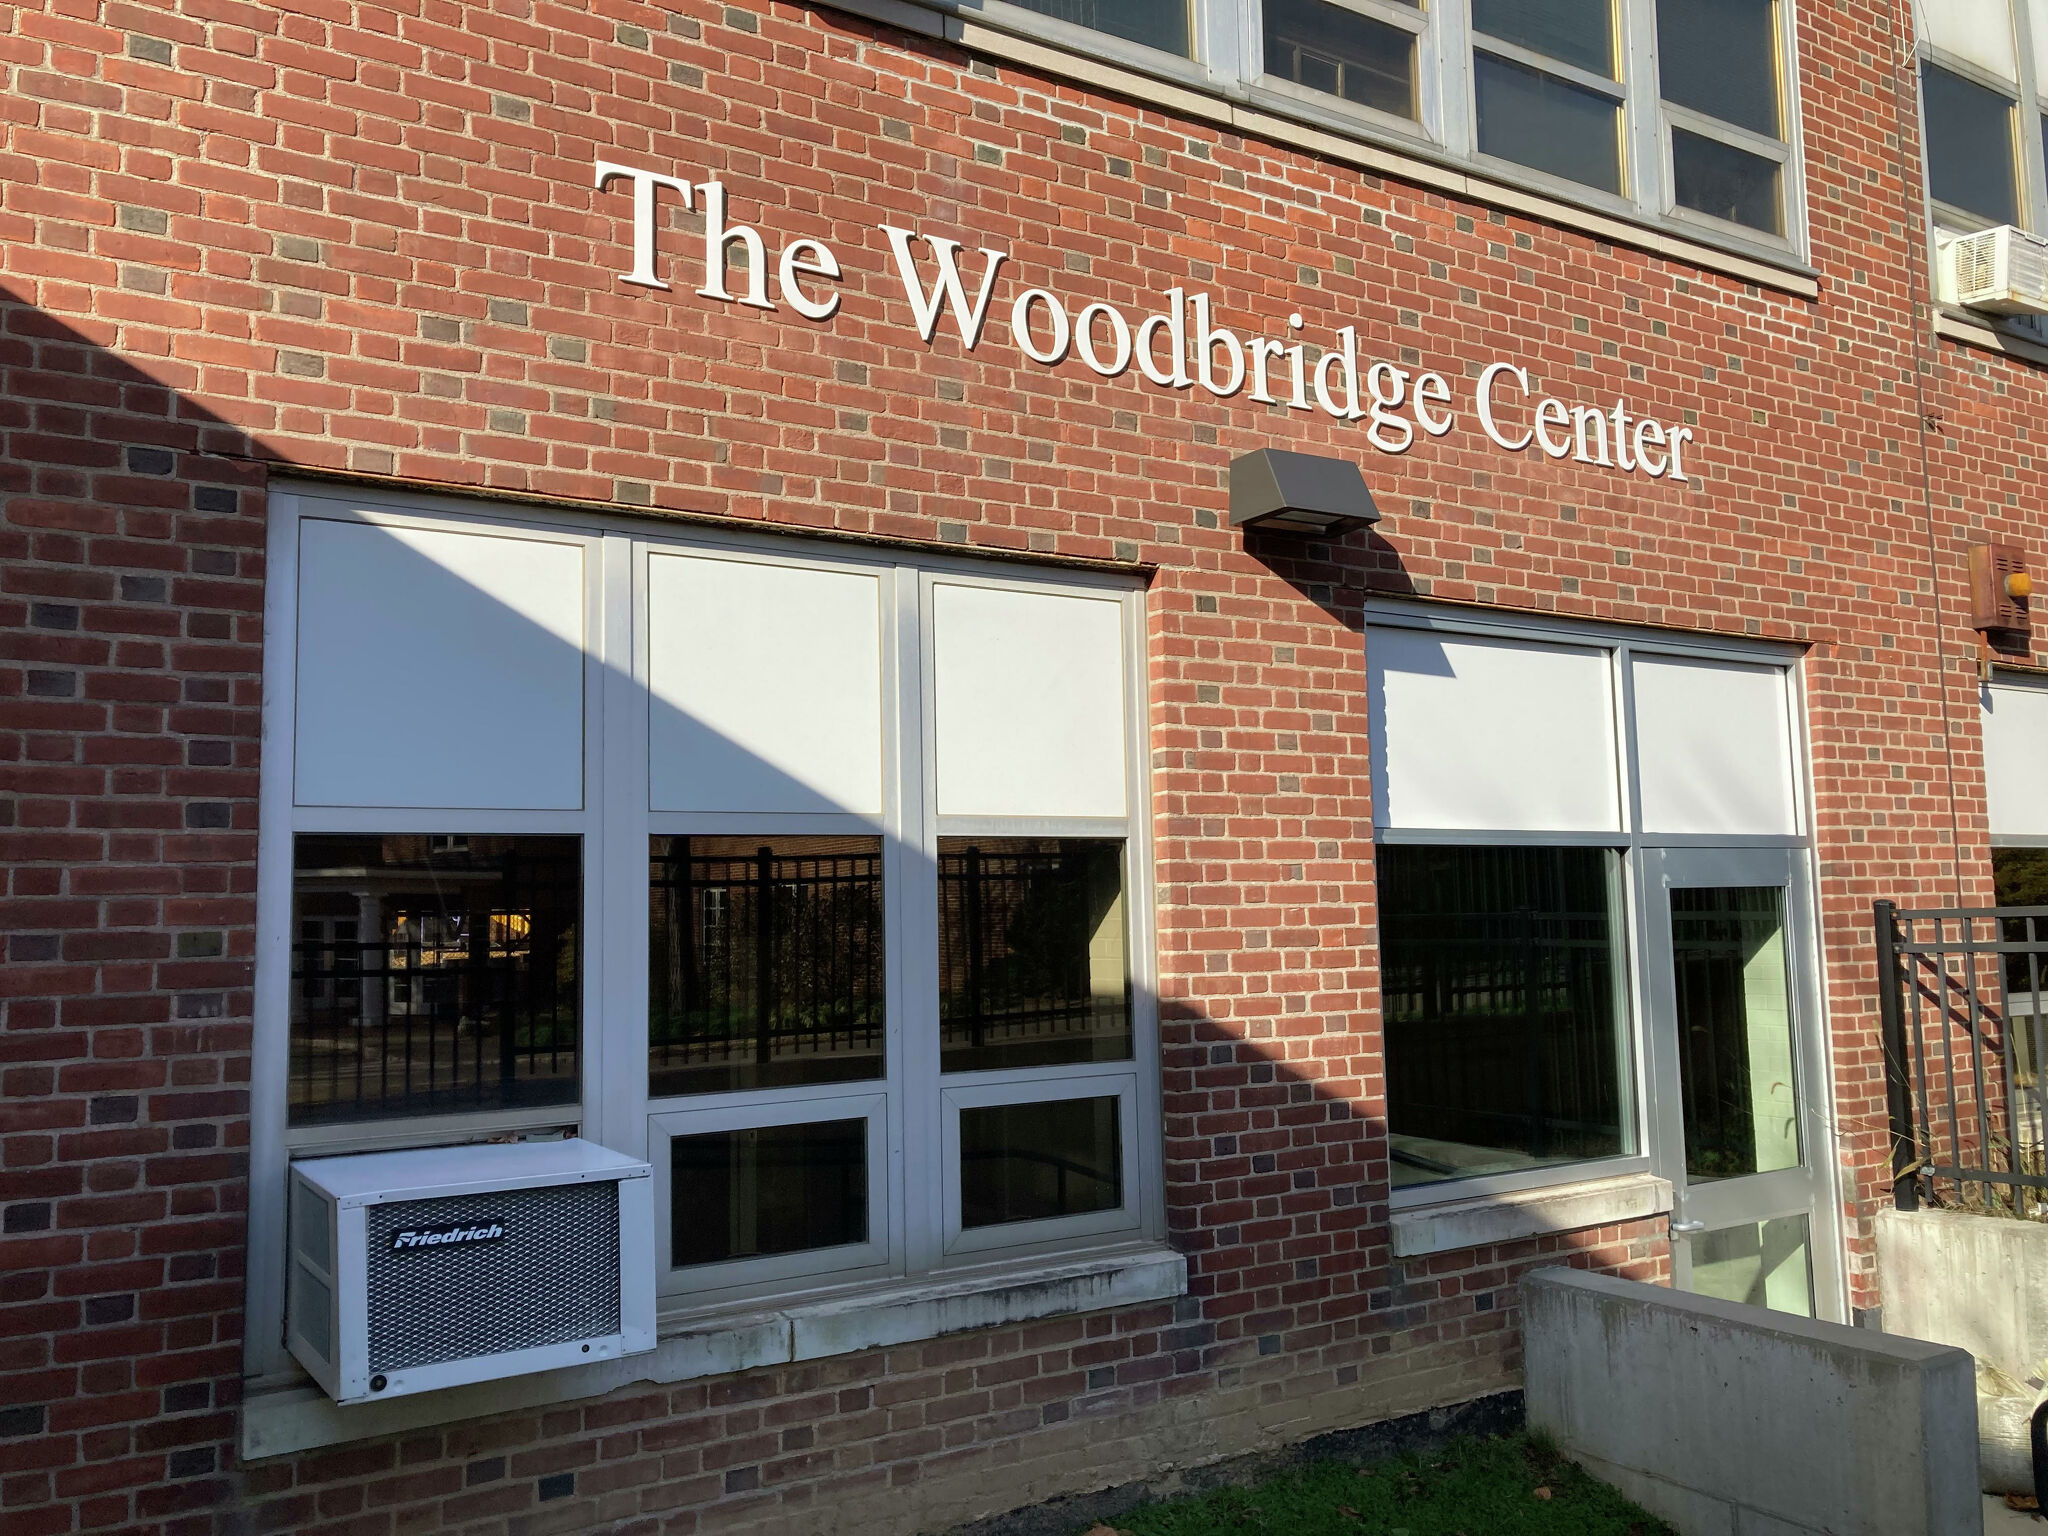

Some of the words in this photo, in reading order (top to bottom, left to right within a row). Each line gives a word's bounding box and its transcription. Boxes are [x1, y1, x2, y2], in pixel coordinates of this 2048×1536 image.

[594, 159, 840, 320] The
[877, 223, 1453, 453] Woodbridge
[1475, 362, 1694, 482] Center
[394, 1224, 503, 1249] Friedrich
